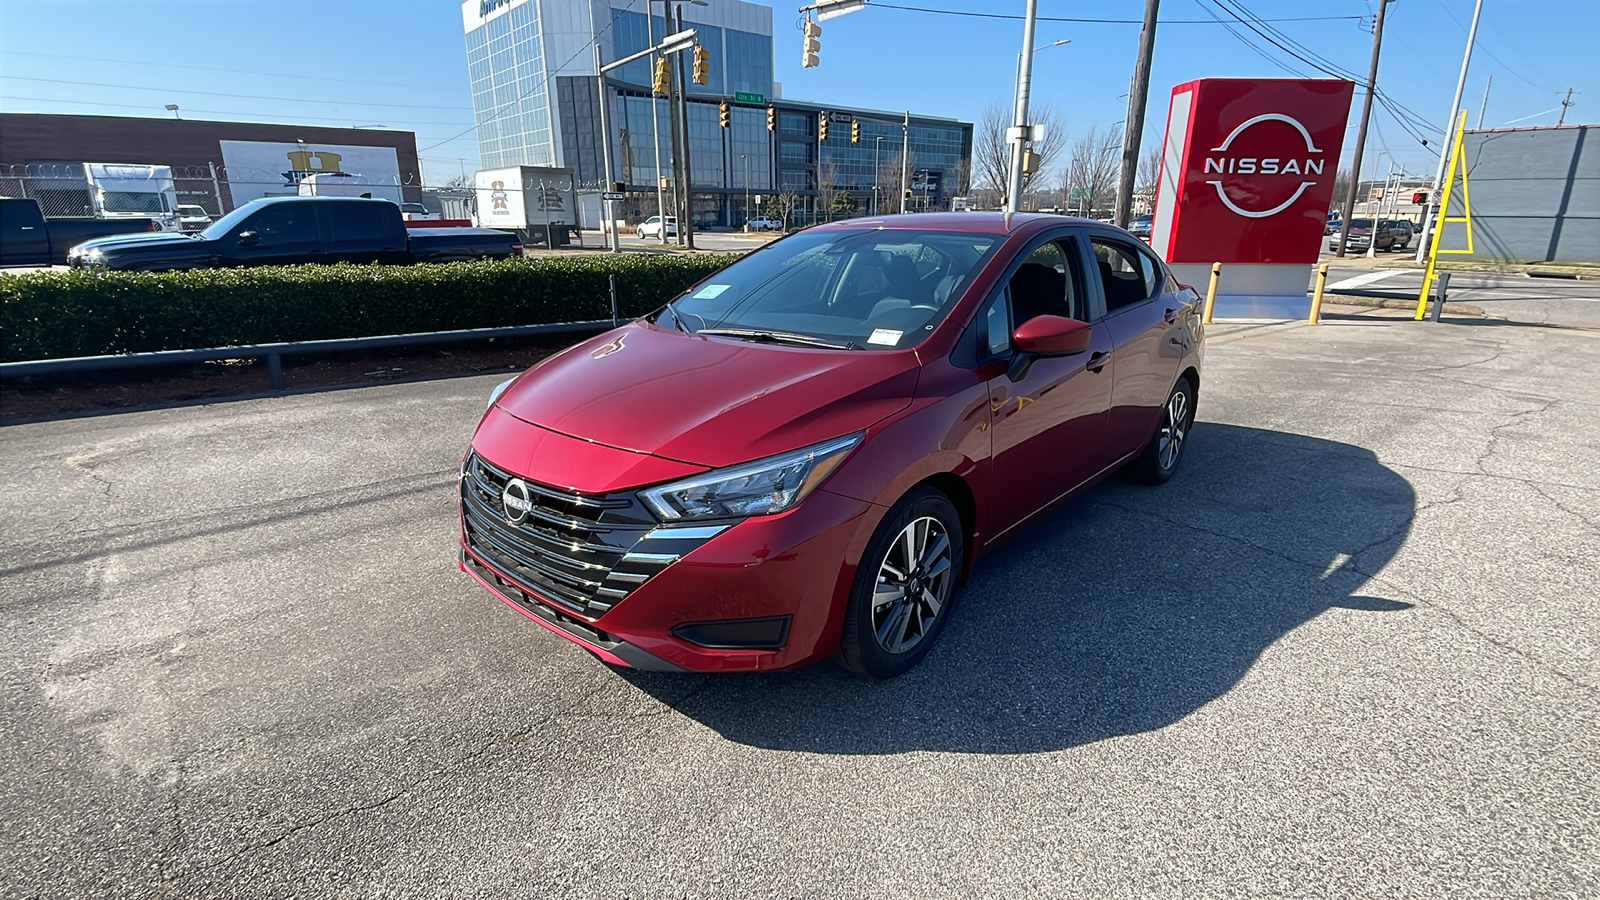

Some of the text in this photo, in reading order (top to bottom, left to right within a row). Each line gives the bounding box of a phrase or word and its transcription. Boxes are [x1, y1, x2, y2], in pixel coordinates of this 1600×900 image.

[1204, 157, 1324, 175] NISSAN
[911, 182, 938, 190] AmFrst
[503, 493, 532, 511] ISSAN
